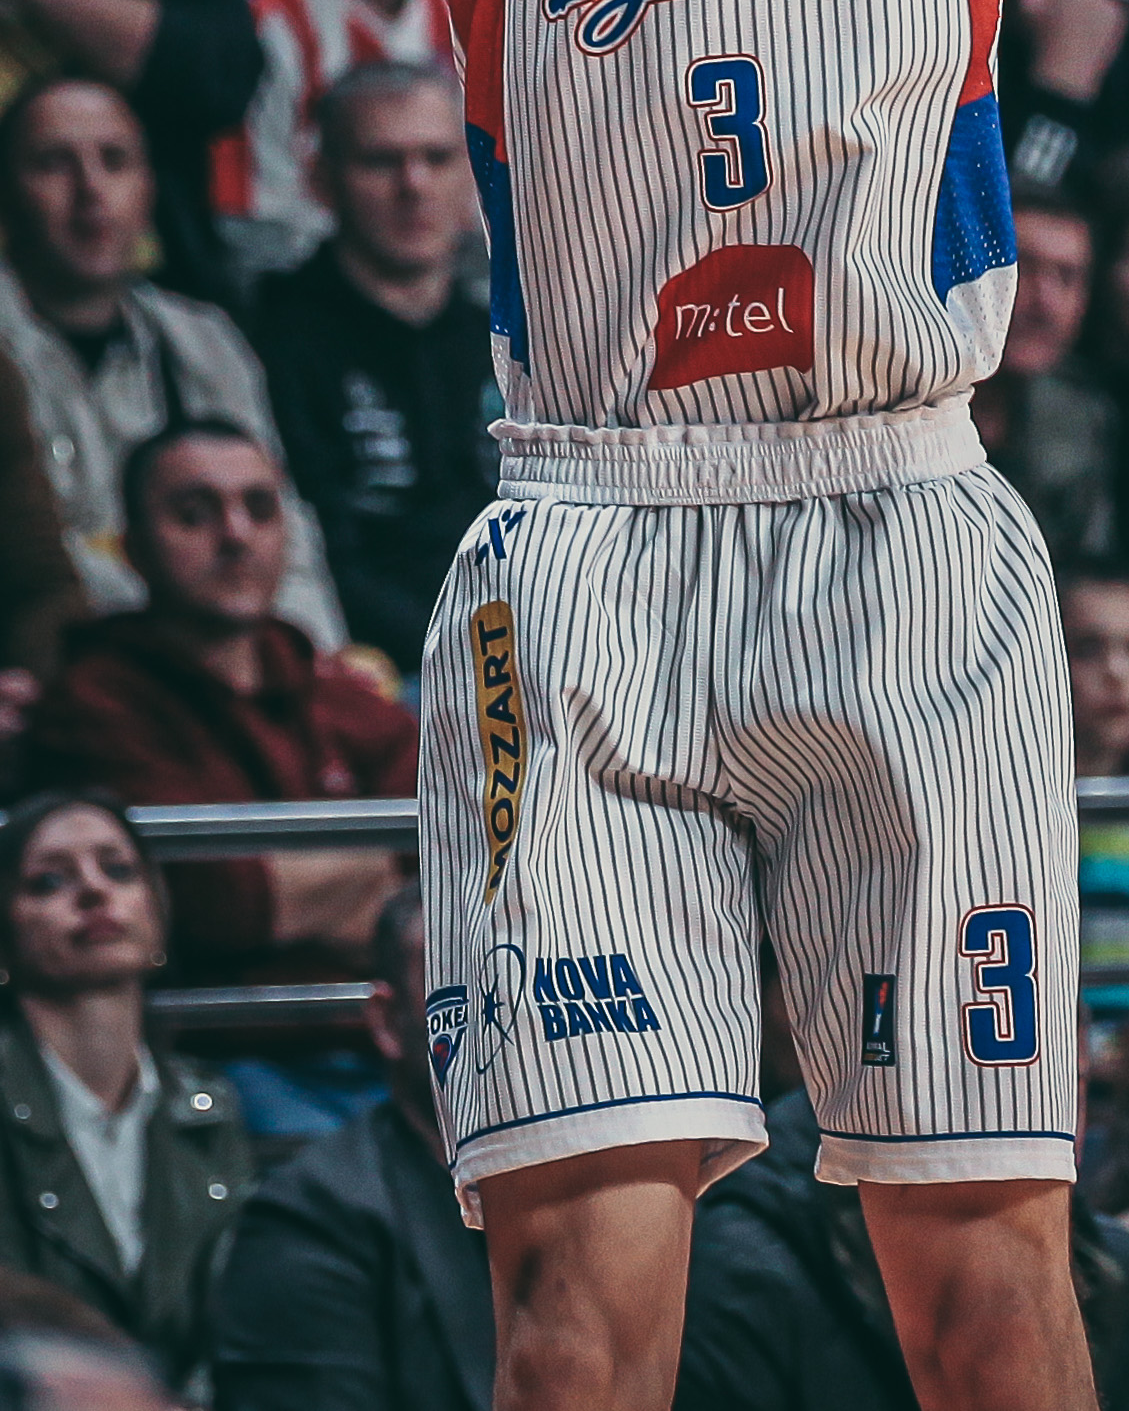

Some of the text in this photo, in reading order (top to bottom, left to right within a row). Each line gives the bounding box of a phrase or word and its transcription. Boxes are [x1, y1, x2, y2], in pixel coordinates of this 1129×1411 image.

[686, 54, 772, 212] 3
[478, 619, 520, 889] MOZZART
[534, 954, 643, 1002] NOVA
[537, 997, 662, 1042] BANKA
[959, 904, 1039, 1067] 3
